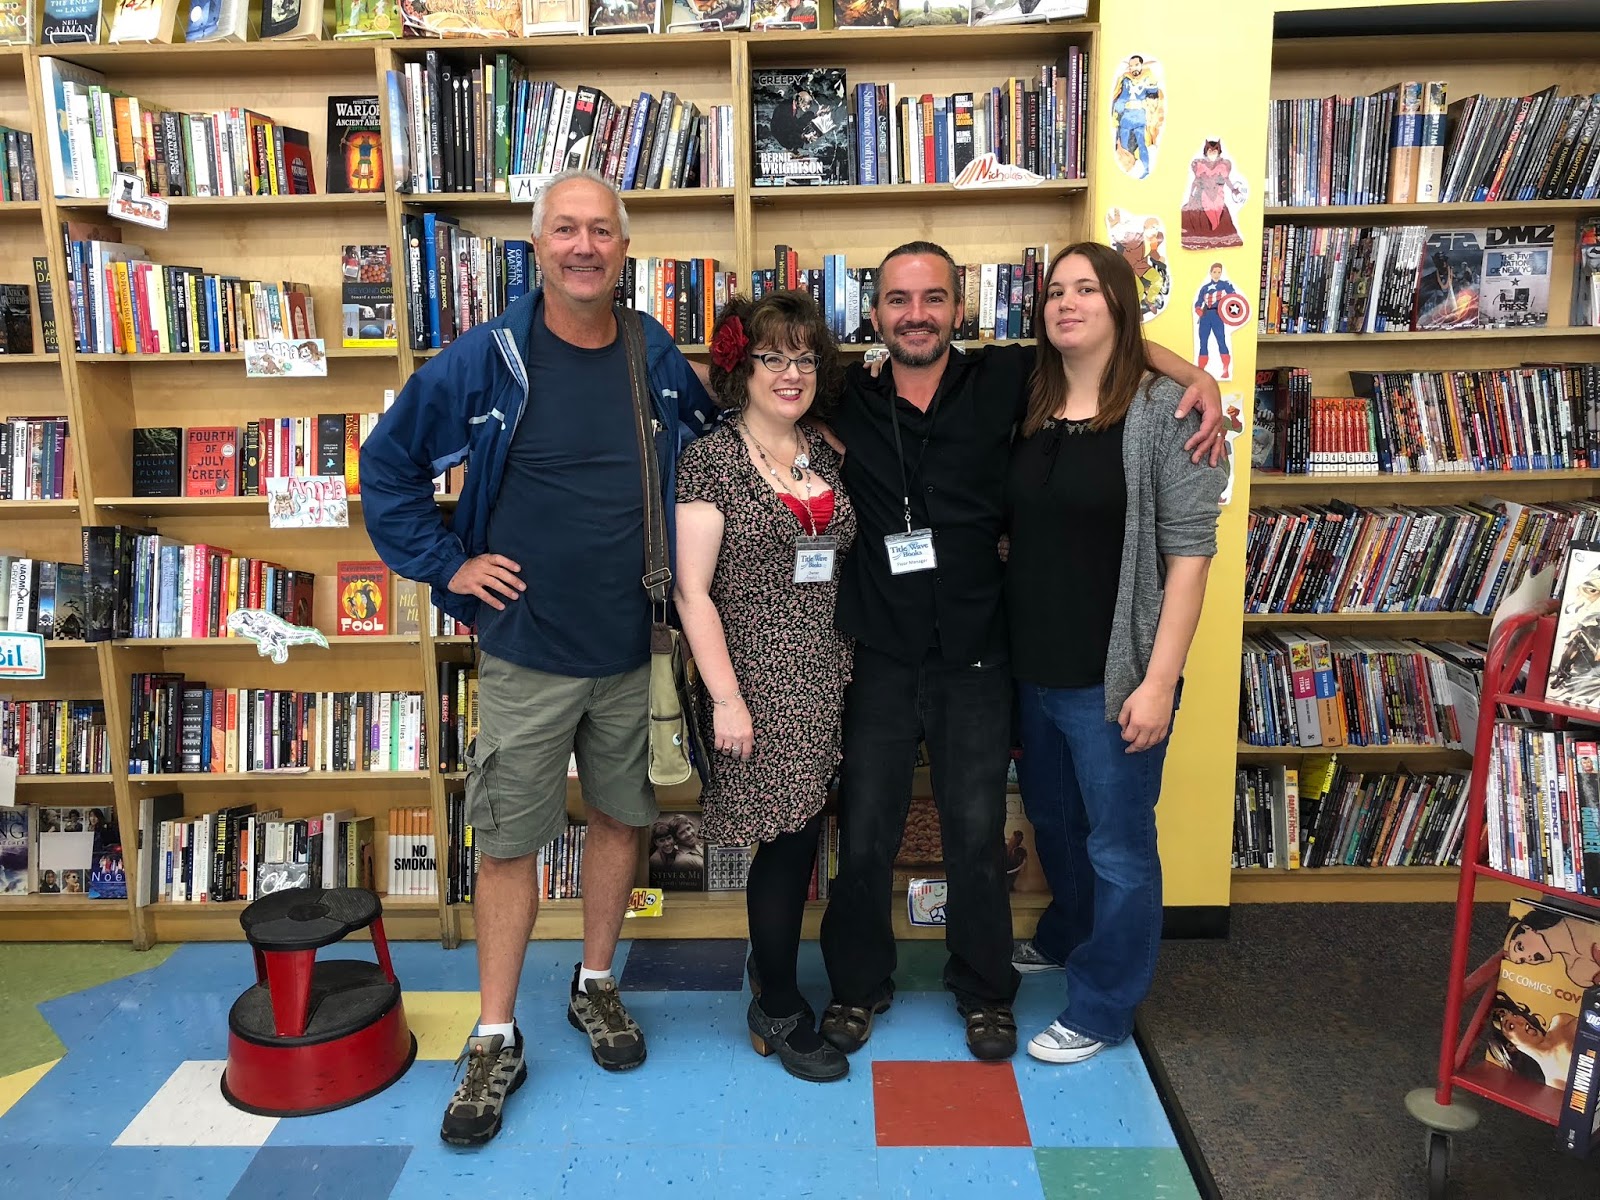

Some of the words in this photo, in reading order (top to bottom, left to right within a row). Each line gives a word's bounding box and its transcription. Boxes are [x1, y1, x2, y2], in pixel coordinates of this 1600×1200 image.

[45, 24, 93, 36] GAIMAN
[759, 75, 802, 86] CREEPY
[863, 90, 872, 107] Short
[864, 108, 872, 128] Stories
[878, 115, 887, 153] CREATURES
[761, 152, 792, 162] BERNIE
[1550, 146, 1568, 186] KNIGHTFALL
[1566, 145, 1586, 186] KNIGHTFALL
[761, 162, 824, 174] WRIGHTSON
[975, 156, 1022, 180] Nicholas
[1491, 226, 1555, 245] DMZ
[120, 272, 126, 280] DO
[411, 251, 420, 293] Elements
[508, 249, 516, 286] MARTIN
[1285, 249, 1293, 284] COMMANDOS
[120, 281, 128, 306] PENGUINS
[428, 270, 436, 299] GNOMES
[1500, 303, 1528, 311] PRESS
[190, 432, 234, 442] FOURTH
[346, 415, 354, 458] PASSAGE
[206, 444, 217, 453] OF
[198, 456, 224, 467] JULY
[192, 470, 230, 480] CREEK
[288, 476, 346, 524] Angela
[1515, 514, 1528, 535] ROUGH
[890, 544, 908, 553] Title
[909, 542, 928, 550] Wave
[1505, 536, 1519, 560] JUSTICE
[340, 575, 382, 583] MOORE
[16, 597, 24, 620] KLEIN
[183, 589, 191, 616] FLUKE
[340, 618, 384, 632] FOOL
[1322, 761, 1336, 793] WATCHMEN
[1288, 794, 1296, 819] GRAPHIC
[218, 814, 226, 840] CLIMBING
[256, 810, 279, 824] Going
[218, 842, 226, 854] FREE
[412, 845, 427, 857] NO
[394, 858, 436, 870] SMOKIN
[1501, 969, 1514, 982] DC
[1516, 975, 1552, 995] COMICS
[1586, 1013, 1600, 1026] DC
[1574, 1054, 1596, 1093] BATMAN
[1570, 1089, 1588, 1114] VAULT
